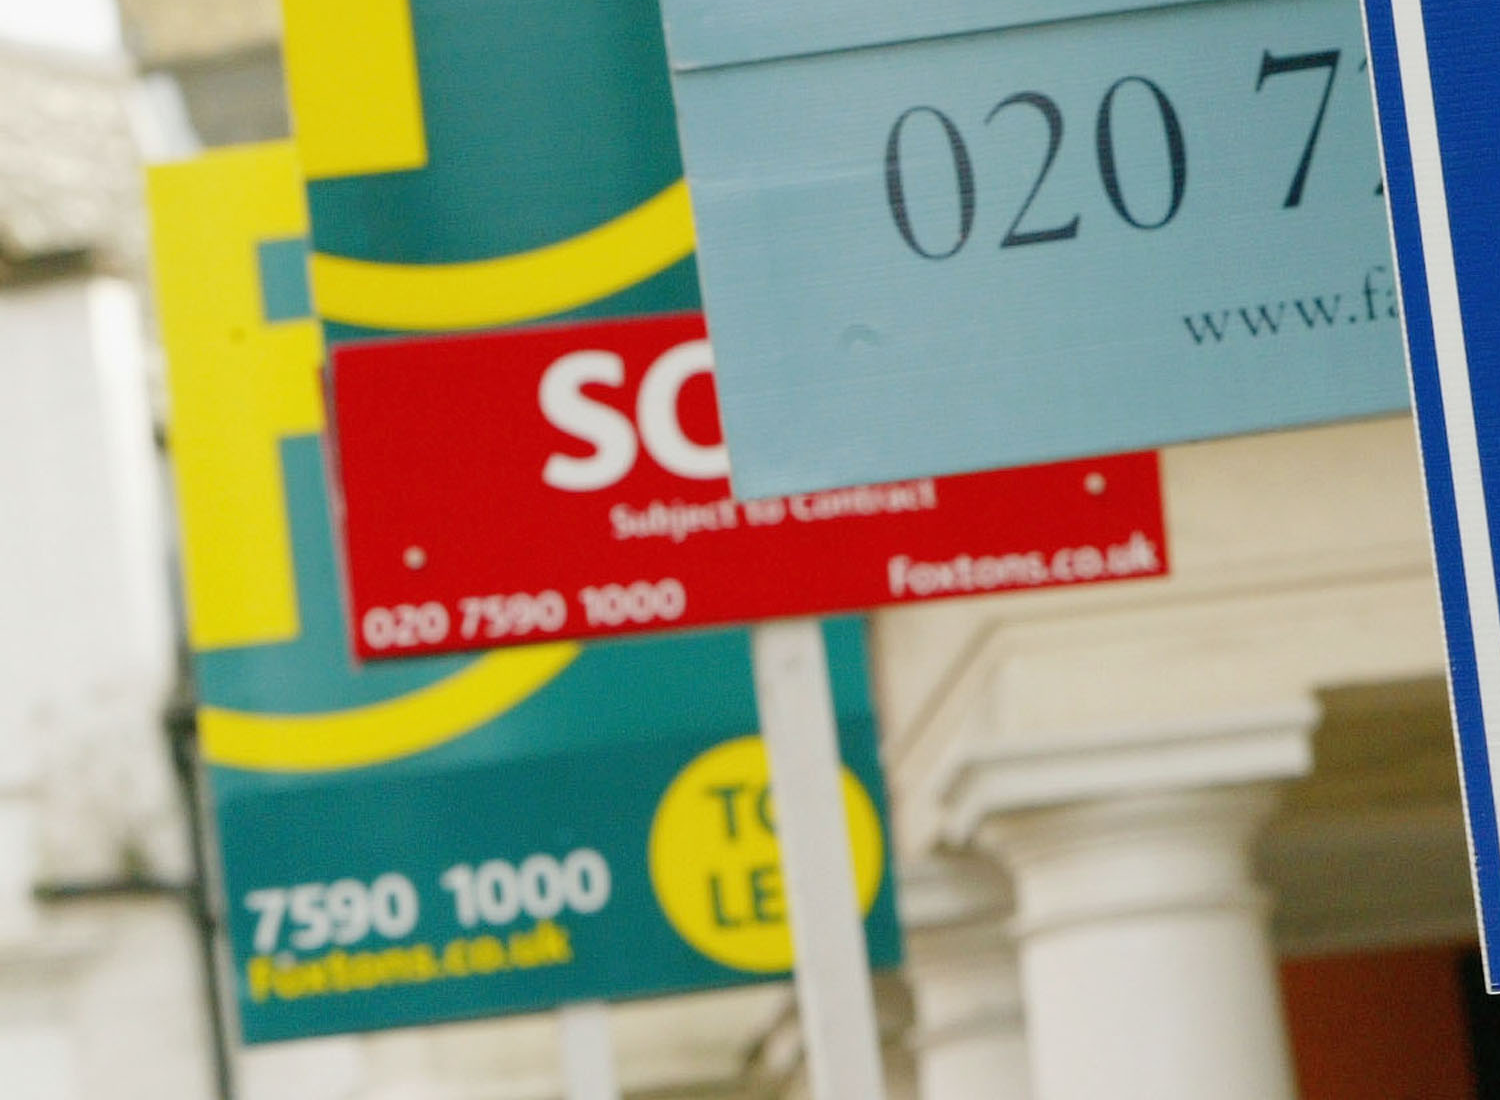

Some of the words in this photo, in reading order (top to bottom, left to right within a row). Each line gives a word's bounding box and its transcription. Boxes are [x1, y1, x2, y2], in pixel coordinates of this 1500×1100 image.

[886, 76, 1188, 260] 020
[1255, 47, 1383, 210] 7
[609, 499, 738, 543] Subject
[743, 500, 787, 527] to
[789, 481, 937, 522] Contract
[886, 533, 1157, 595] Foxtons.co.uk
[363, 603, 448, 648] 020
[461, 591, 566, 637] 7590
[581, 580, 685, 625] 1000
[248, 875, 417, 952] 7590
[444, 851, 609, 931] 1000
[248, 920, 568, 1000] Foxtons.co.uk
